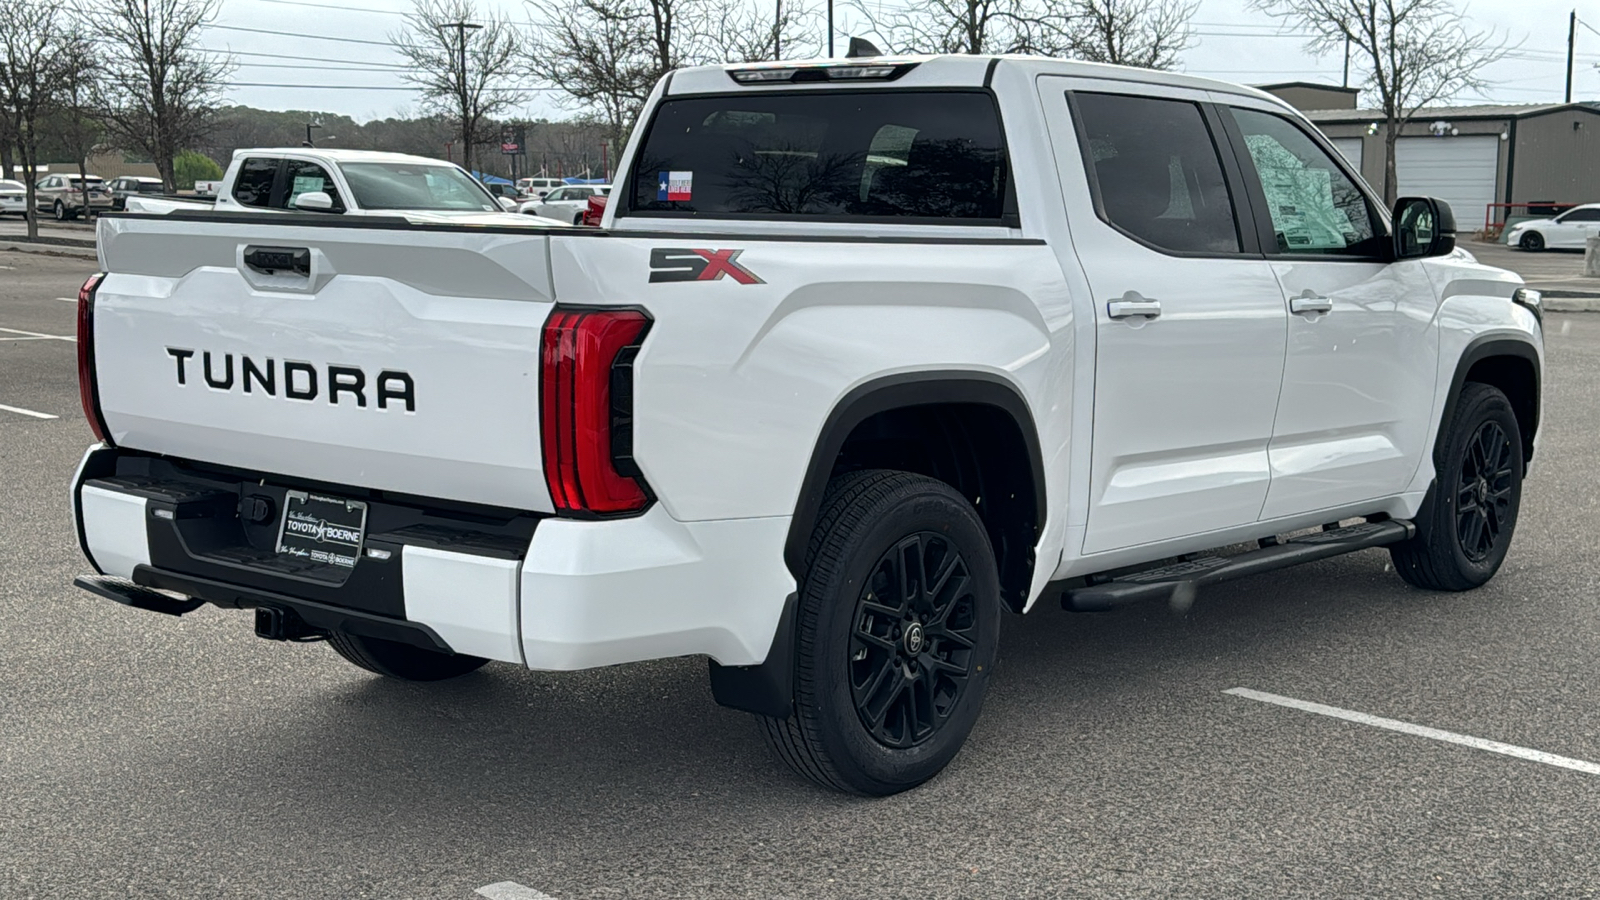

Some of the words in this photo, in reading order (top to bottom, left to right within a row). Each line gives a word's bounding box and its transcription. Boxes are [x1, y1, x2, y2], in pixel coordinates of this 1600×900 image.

[165, 346, 416, 412] TUNDRA
[287, 520, 316, 533] TOYOTA
[327, 527, 360, 542] BOERNE
[311, 551, 328, 560] TOYOTA
[335, 557, 354, 565] BOERNE
